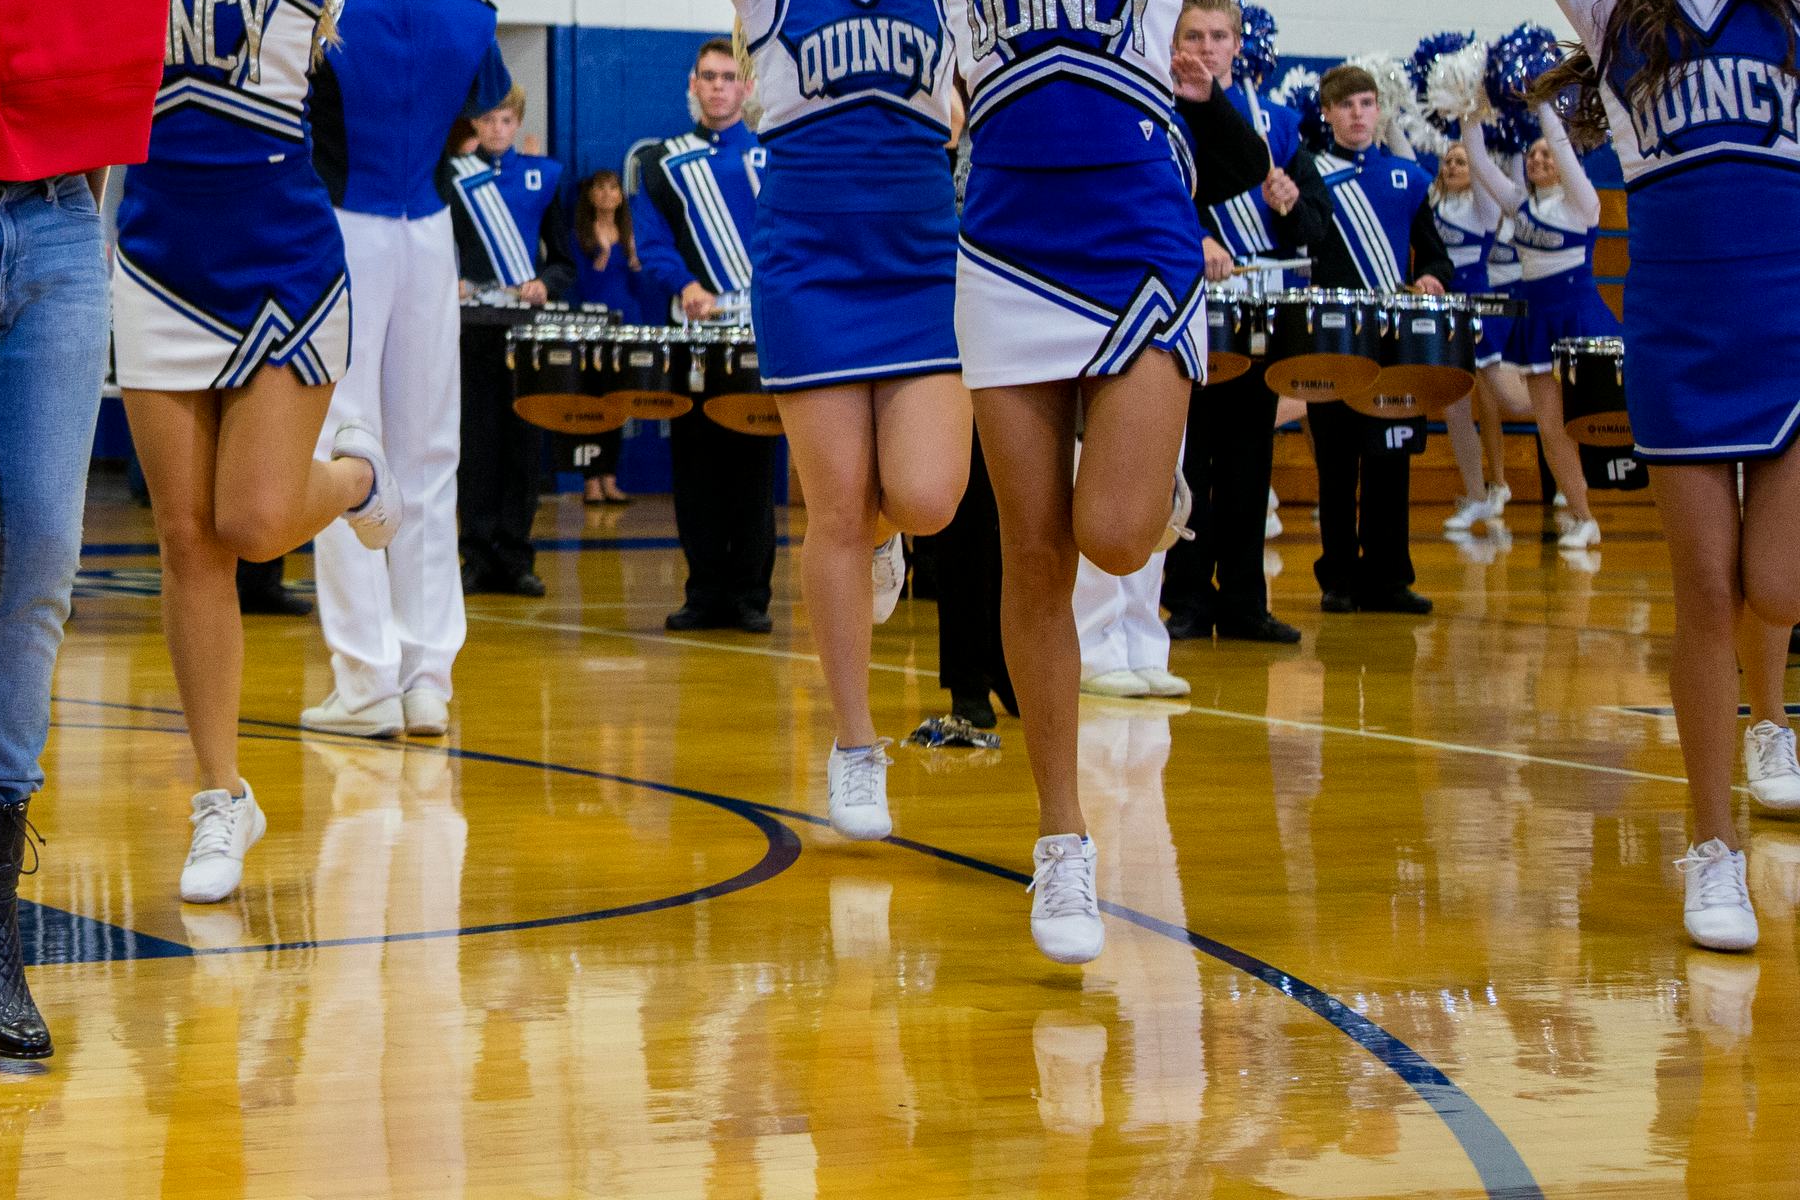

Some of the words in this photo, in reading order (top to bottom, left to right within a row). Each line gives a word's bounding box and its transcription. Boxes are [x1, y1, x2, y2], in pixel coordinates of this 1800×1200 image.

[800, 16, 937, 96] QUINCY
[1630, 57, 1798, 153] QUINCY
[1300, 380, 1335, 390] YAMAHA
